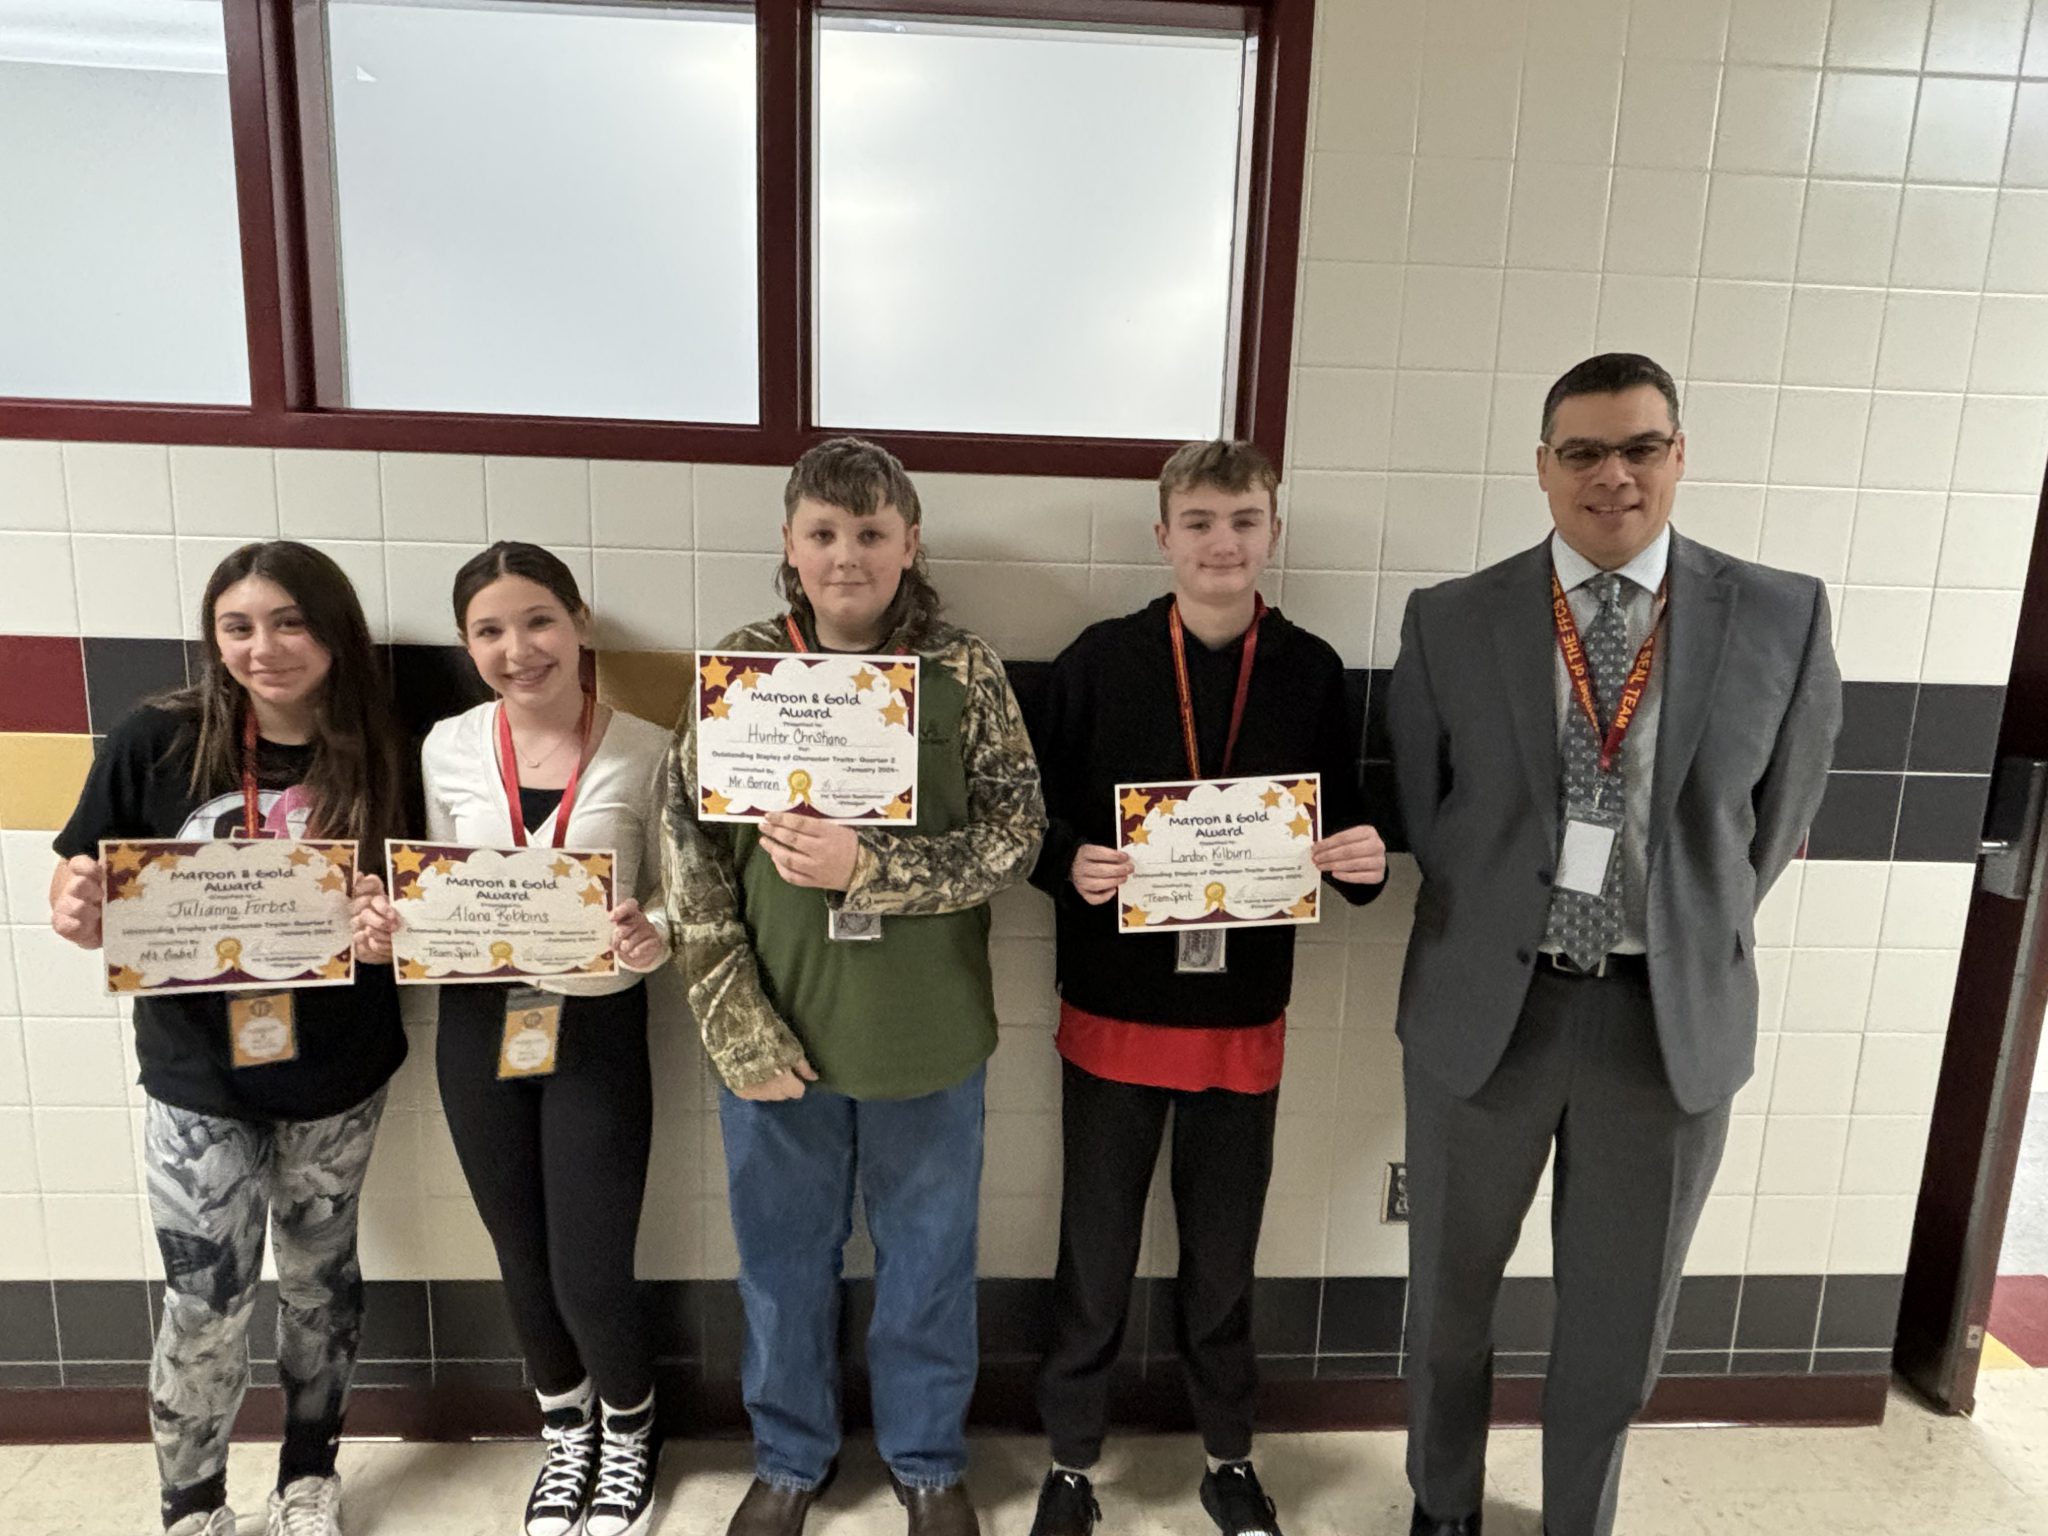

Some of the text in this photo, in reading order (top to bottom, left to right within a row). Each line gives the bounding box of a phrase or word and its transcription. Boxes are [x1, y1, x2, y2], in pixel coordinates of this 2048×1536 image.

[1562, 633, 1581, 662] THE
[1570, 663, 1585, 677] of
[1629, 650, 1651, 684] SEAL
[751, 692, 861, 705] Maroon & Gold
[779, 707, 832, 719] Award
[1615, 688, 1641, 728] TEAM
[748, 723, 789, 744] Hunter
[1169, 811, 1270, 827] Maroon & Gold
[1195, 826, 1244, 838] Award
[170, 869, 236, 881] Maroon
[255, 868, 296, 879] Gold
[204, 881, 264, 893] Award
[446, 877, 559, 889] Maroon & Gold
[476, 891, 530, 901] Award
[245, 899, 296, 915] Forbes
